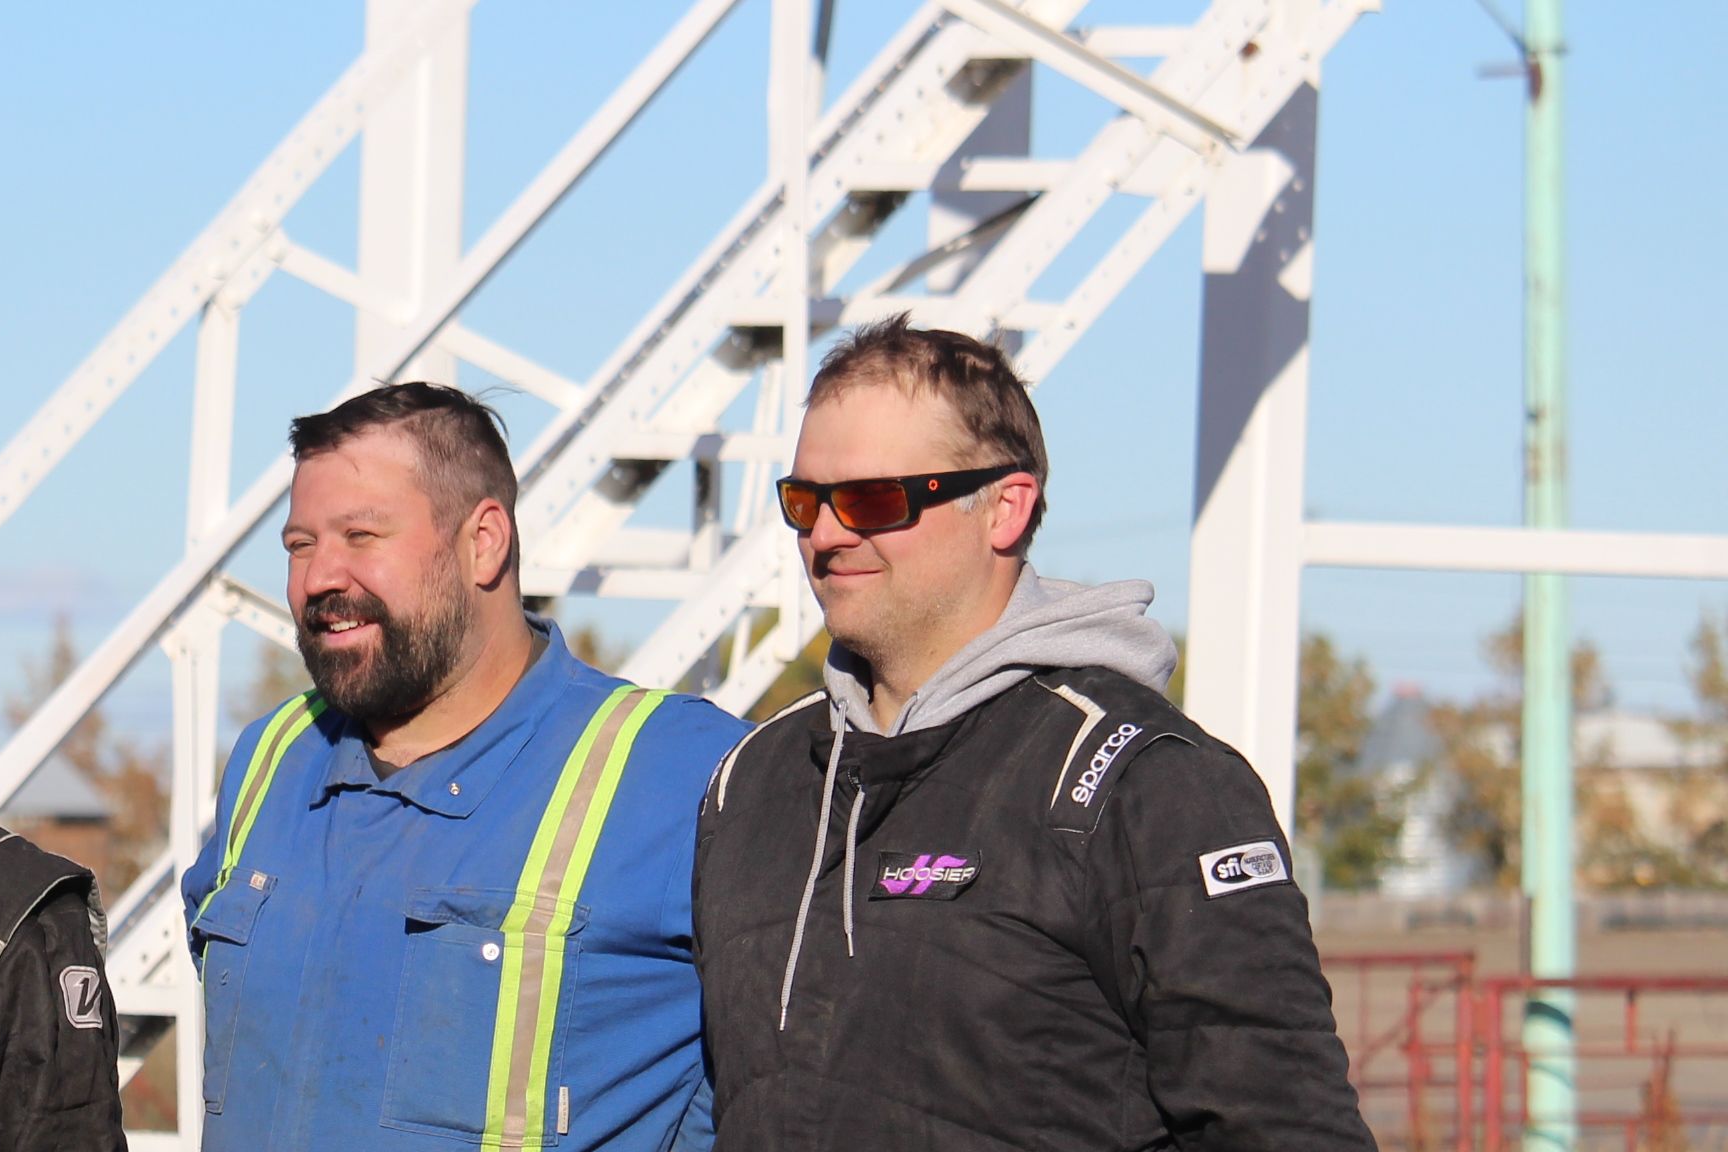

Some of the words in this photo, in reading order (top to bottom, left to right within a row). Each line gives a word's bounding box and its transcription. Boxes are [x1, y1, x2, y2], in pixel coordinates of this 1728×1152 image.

[1072, 723, 1138, 804] sparco
[883, 866, 976, 882] HOOSIER
[1217, 857, 1242, 880] sfi
